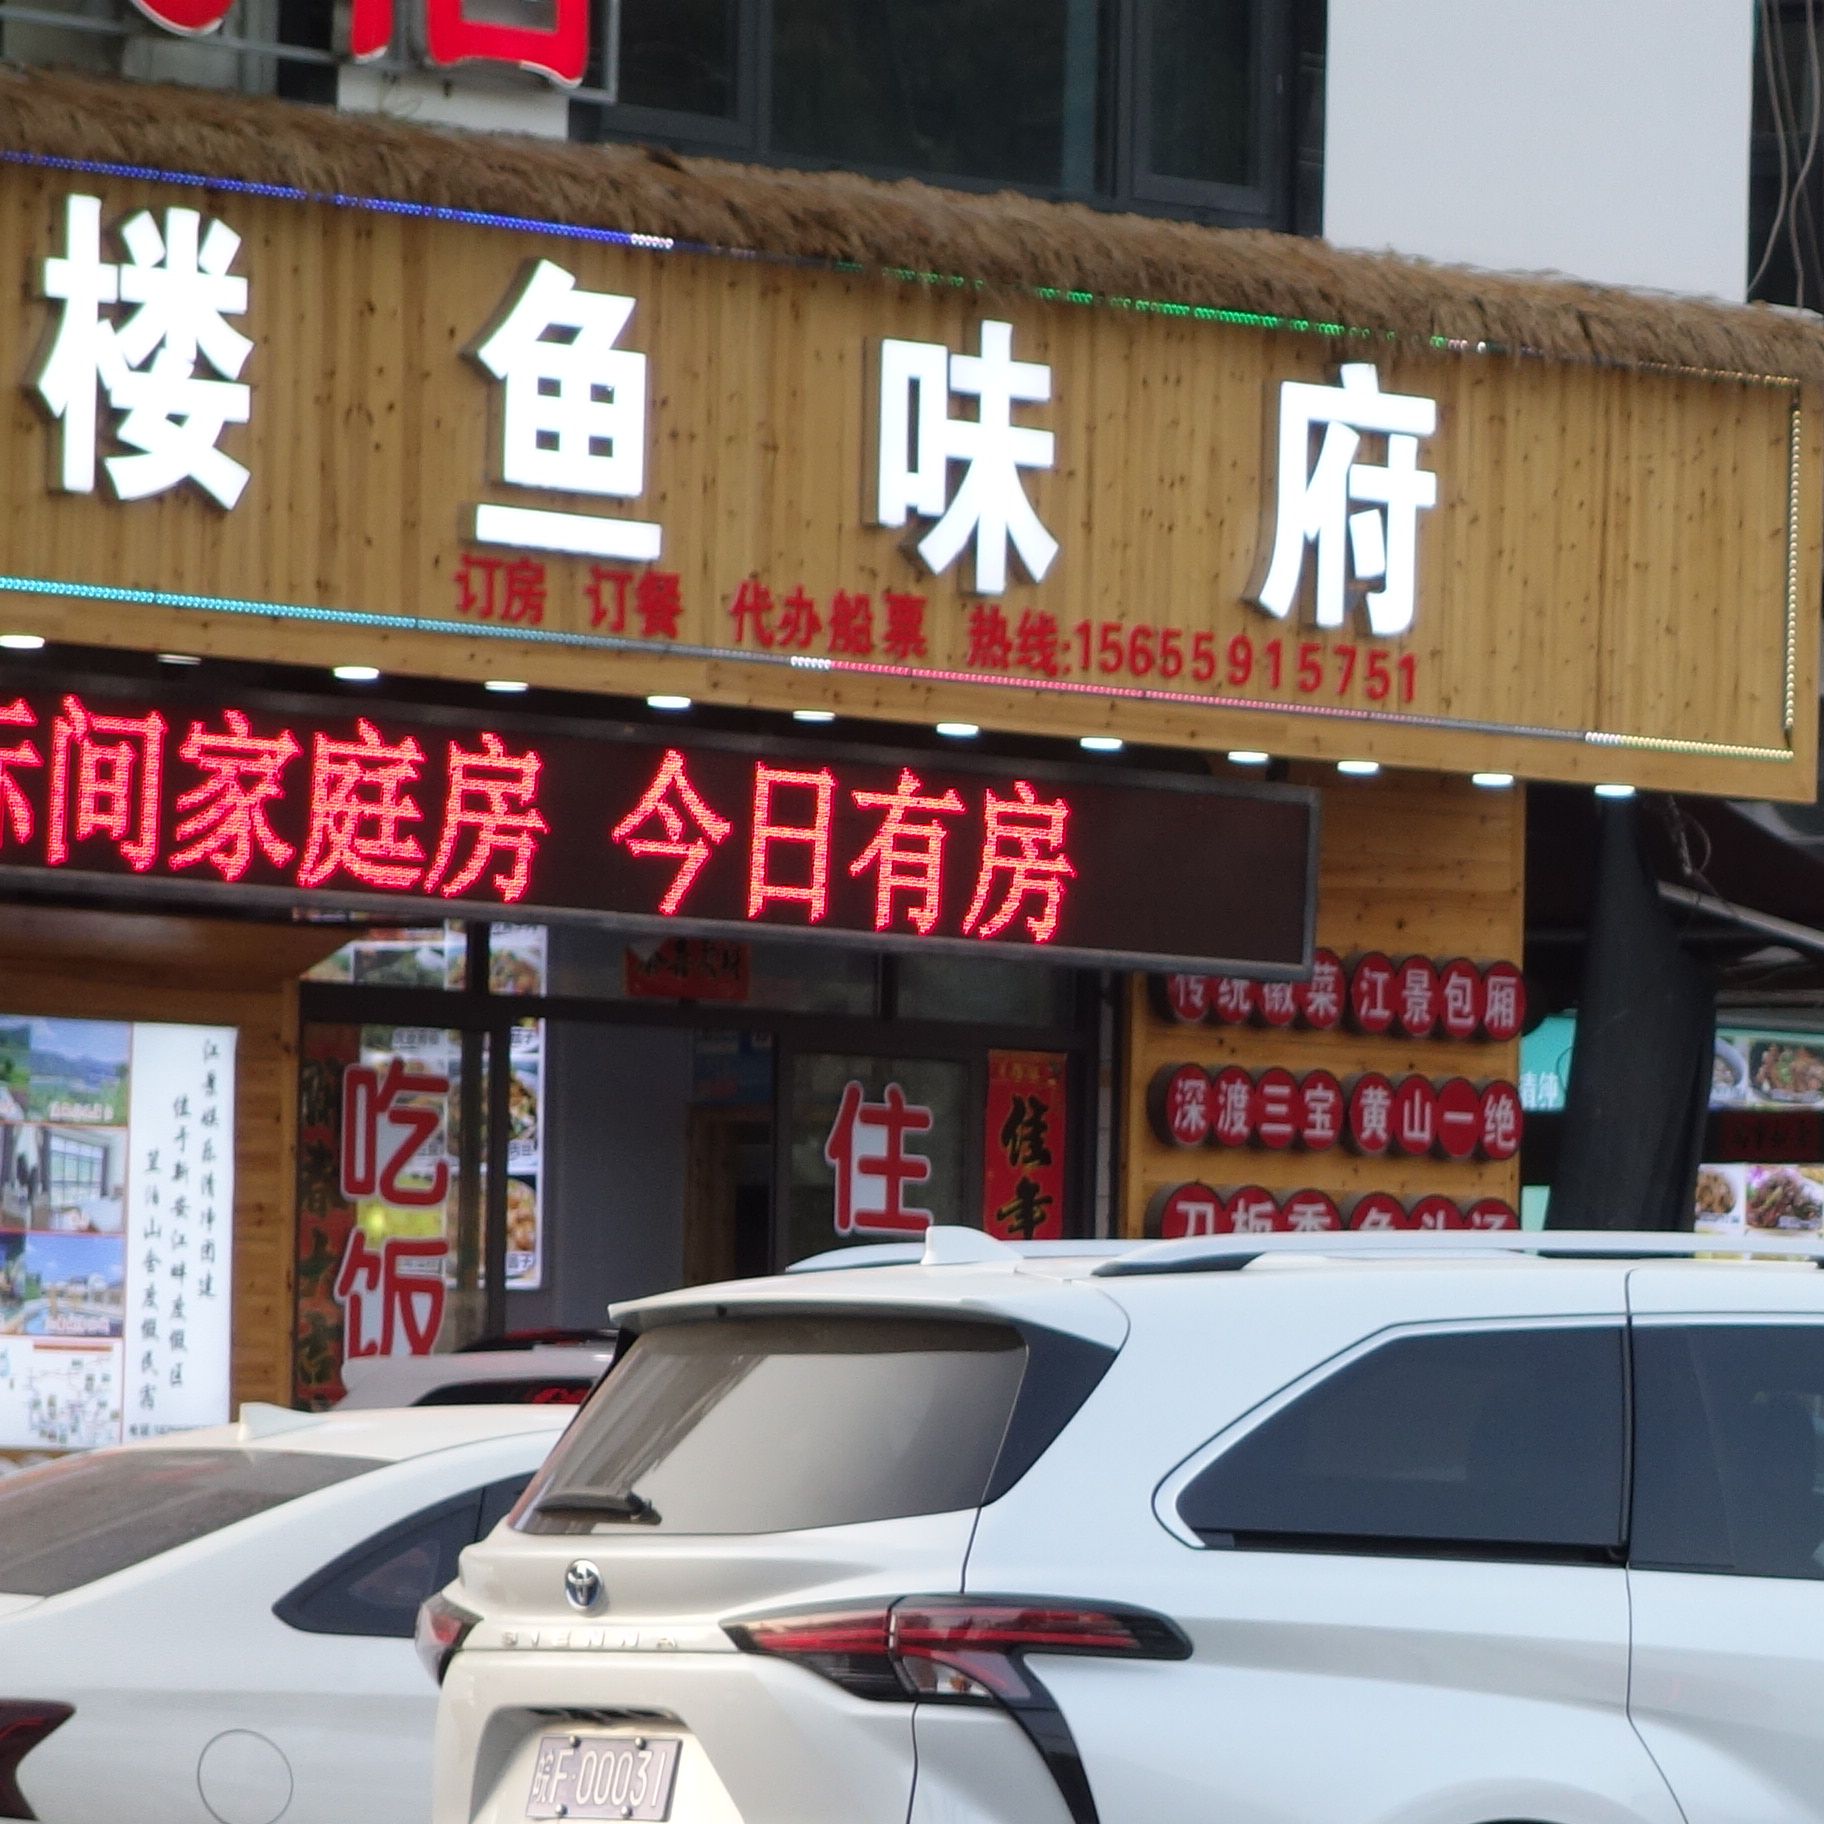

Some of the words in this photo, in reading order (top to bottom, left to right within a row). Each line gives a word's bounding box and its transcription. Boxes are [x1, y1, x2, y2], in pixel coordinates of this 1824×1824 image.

[35, 193, 1438, 636] 楼鱼味府
[455, 553, 547, 625] 订房
[586, 563, 683, 639] 订餐
[730, 577, 929, 659] 代办船票
[613, 748, 1077, 943] 今日有房
[1176, 961, 1340, 1019] 传统徽菜
[1359, 965, 1519, 1030] 江景包厢
[827, 1079, 934, 1237] 住
[1173, 1077, 1338, 1139] 深渡三宝
[1358, 1085, 1517, 1151] 黄山一绝
[336, 1055, 450, 1357] 吃饭
[502, 1630, 679, 1650] SIENNA
